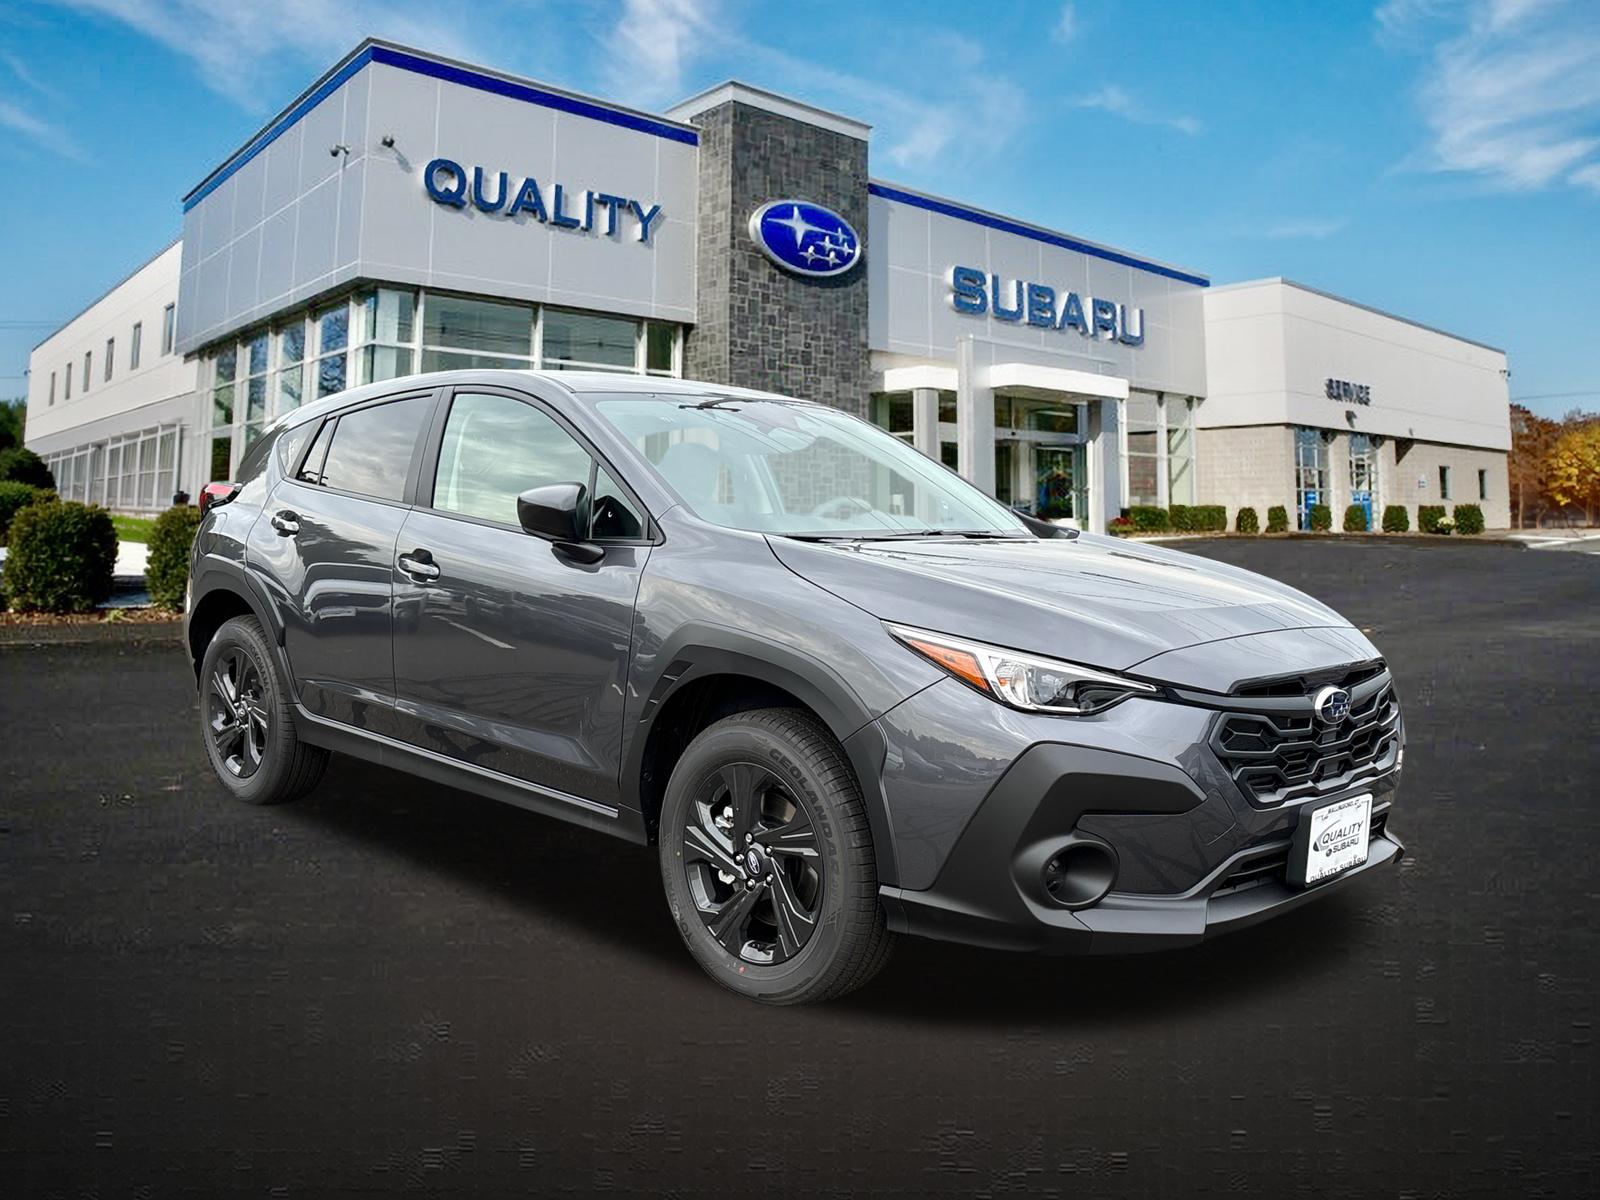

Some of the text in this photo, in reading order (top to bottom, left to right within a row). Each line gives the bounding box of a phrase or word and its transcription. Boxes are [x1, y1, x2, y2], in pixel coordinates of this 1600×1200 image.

[423, 158, 662, 243] QUALITY
[949, 265, 1145, 347] SUBARU
[1324, 377, 1371, 406] SERVICE
[768, 748, 840, 878] GEOLANDAR
[1322, 821, 1363, 844] QUALITY
[1332, 837, 1359, 853] SUBARU
[1309, 855, 1367, 881] QUALITY SUBARU
